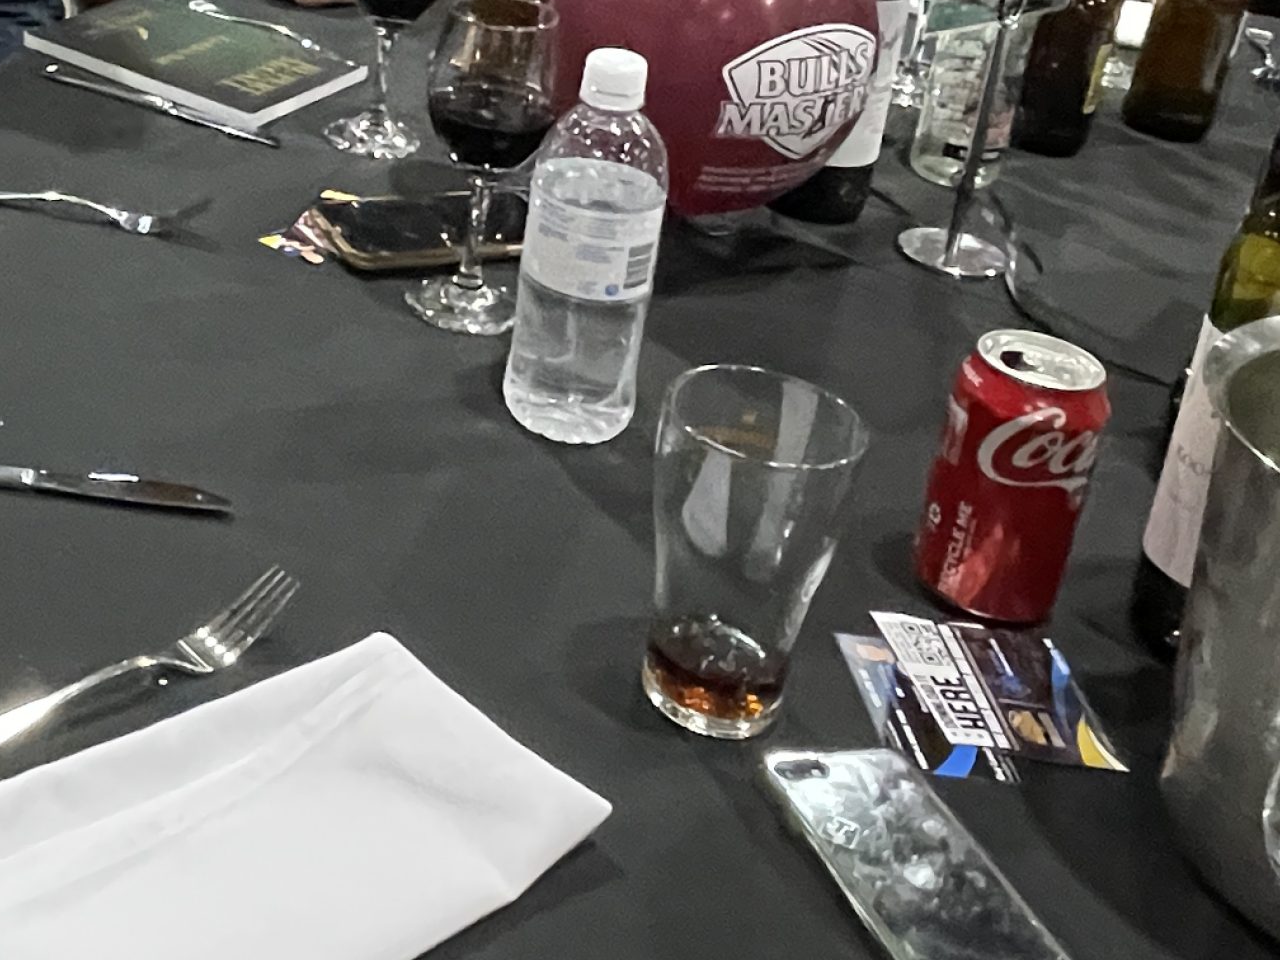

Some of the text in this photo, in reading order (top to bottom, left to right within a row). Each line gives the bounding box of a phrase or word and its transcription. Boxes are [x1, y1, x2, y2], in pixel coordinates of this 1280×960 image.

[755, 41, 870, 99] BULLS
[717, 82, 867, 137] MASTER
[930, 675, 988, 729] HERE
